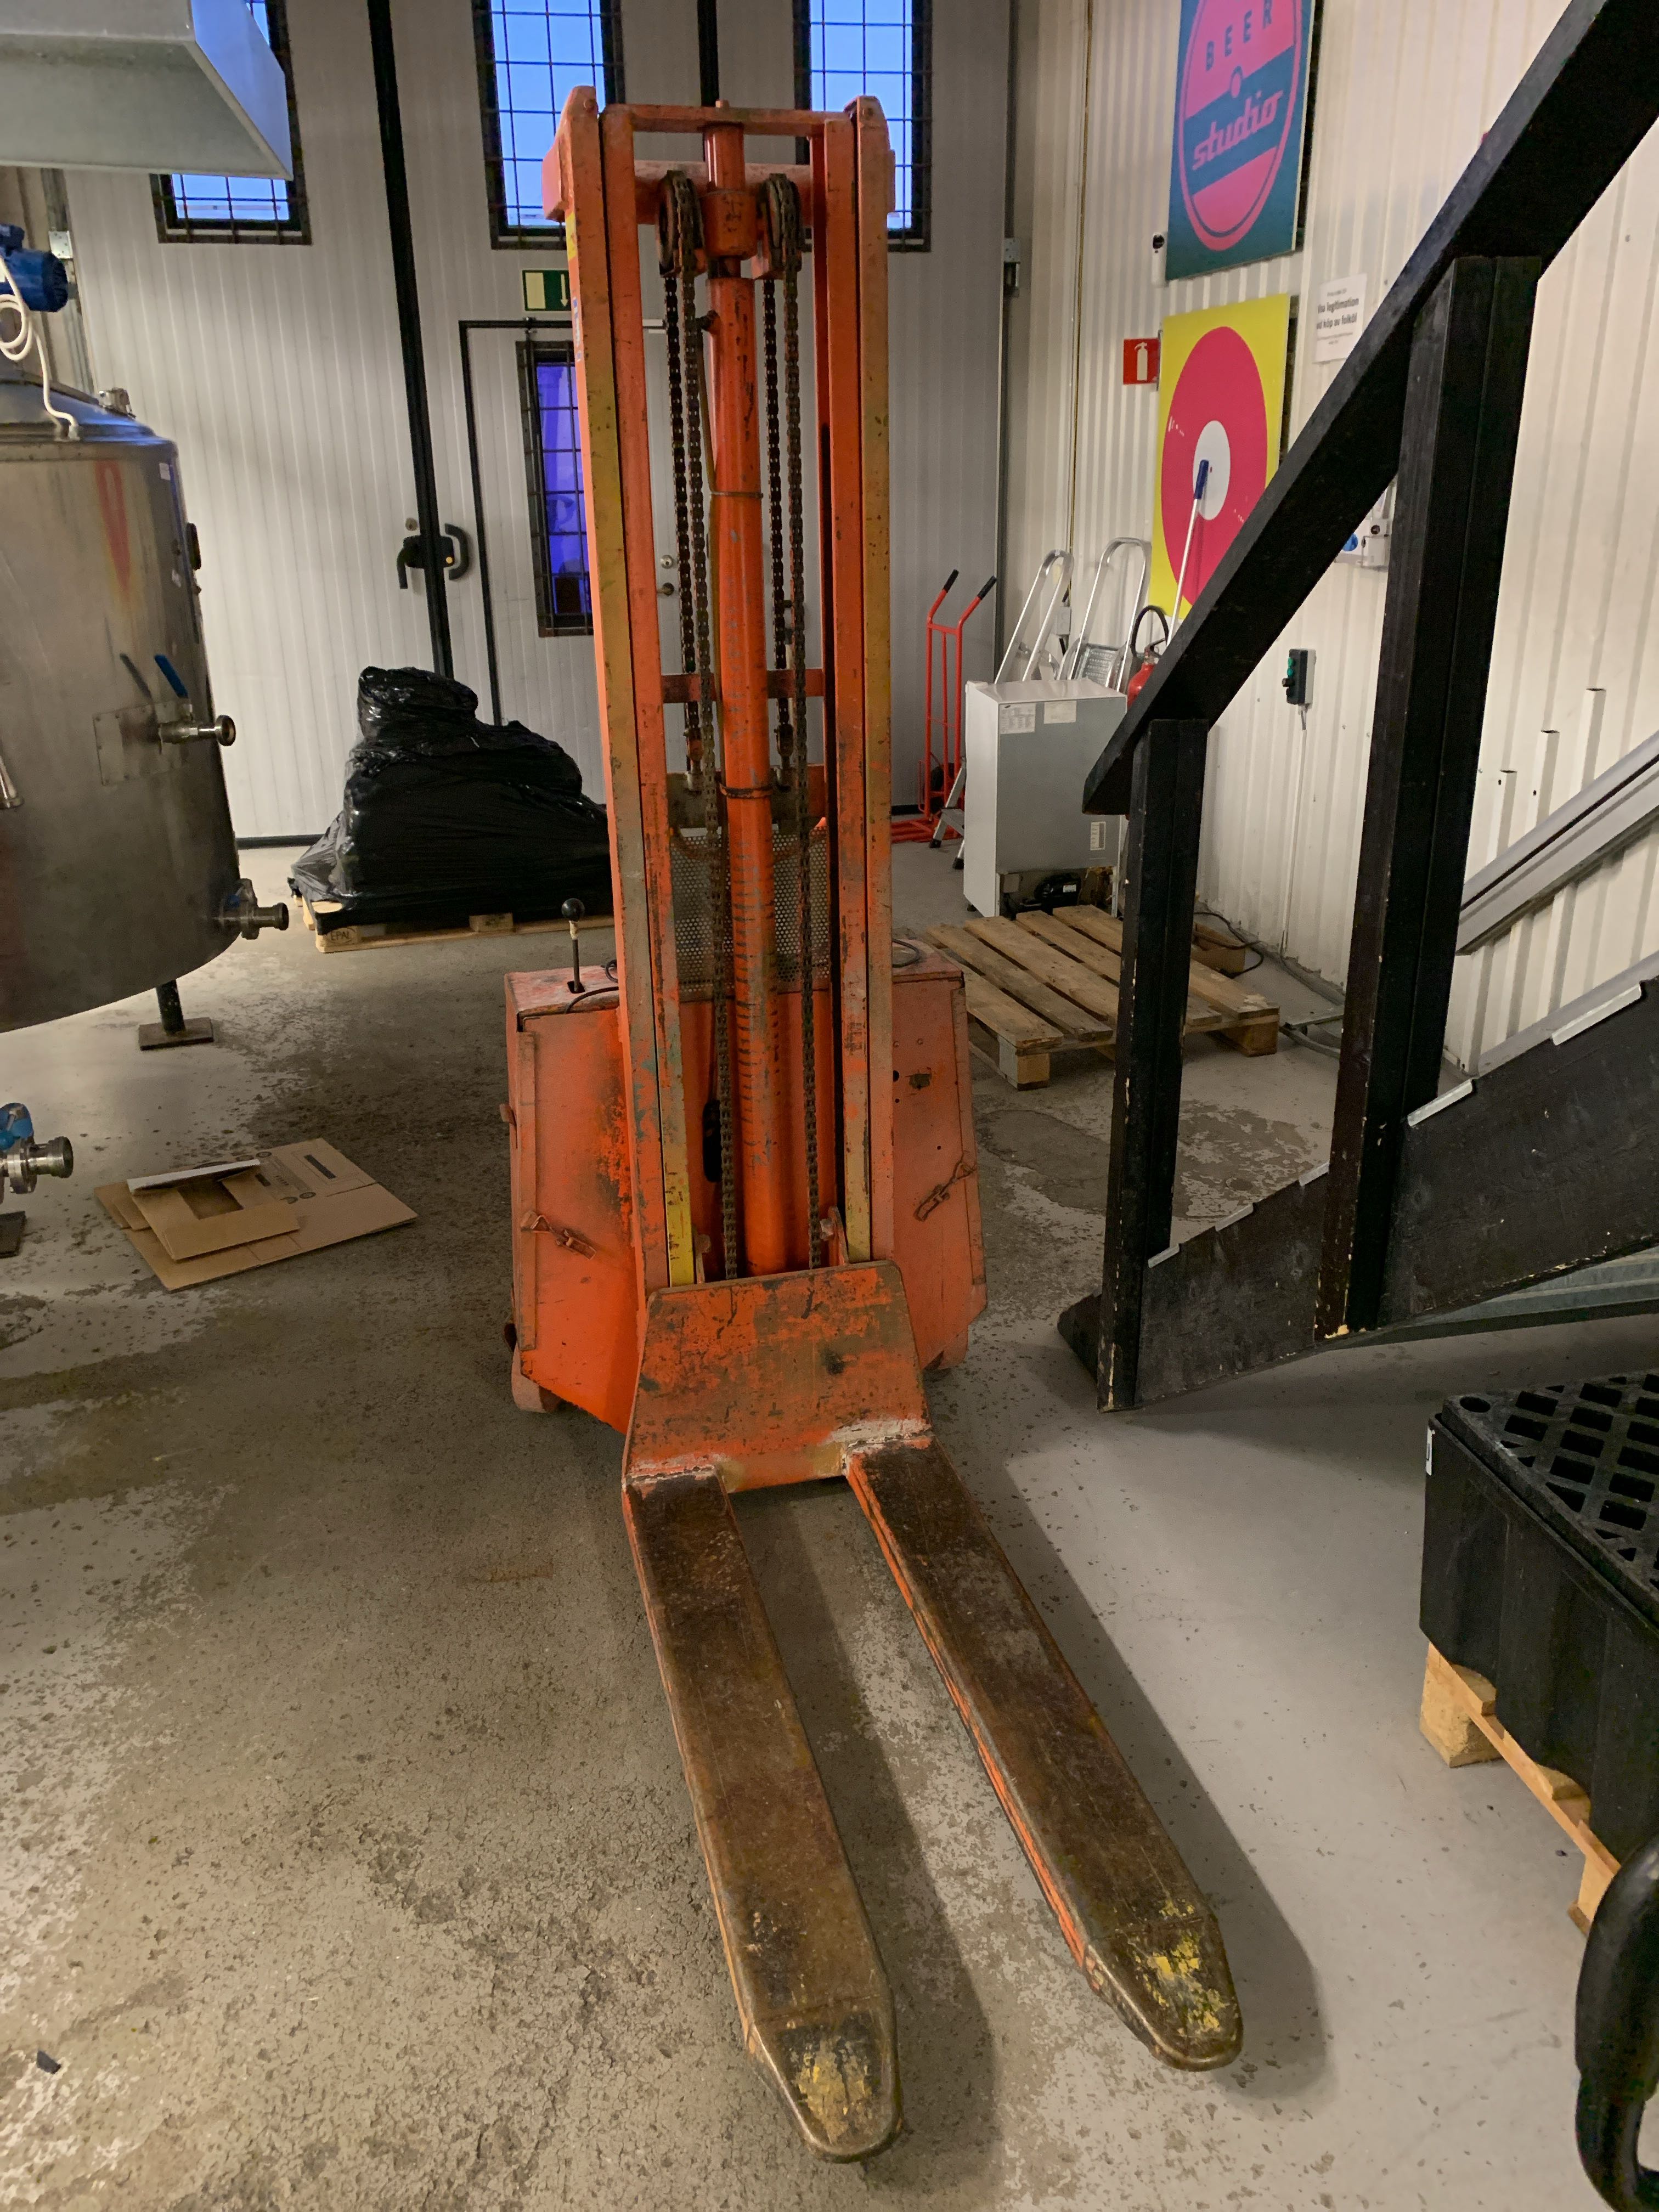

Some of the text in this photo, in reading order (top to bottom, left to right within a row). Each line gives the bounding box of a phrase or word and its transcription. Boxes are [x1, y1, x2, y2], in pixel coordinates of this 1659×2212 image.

[1206, 0, 1272, 71] BEER
[1192, 91, 1283, 171] studio
[330, 931, 349, 941] EPAL
